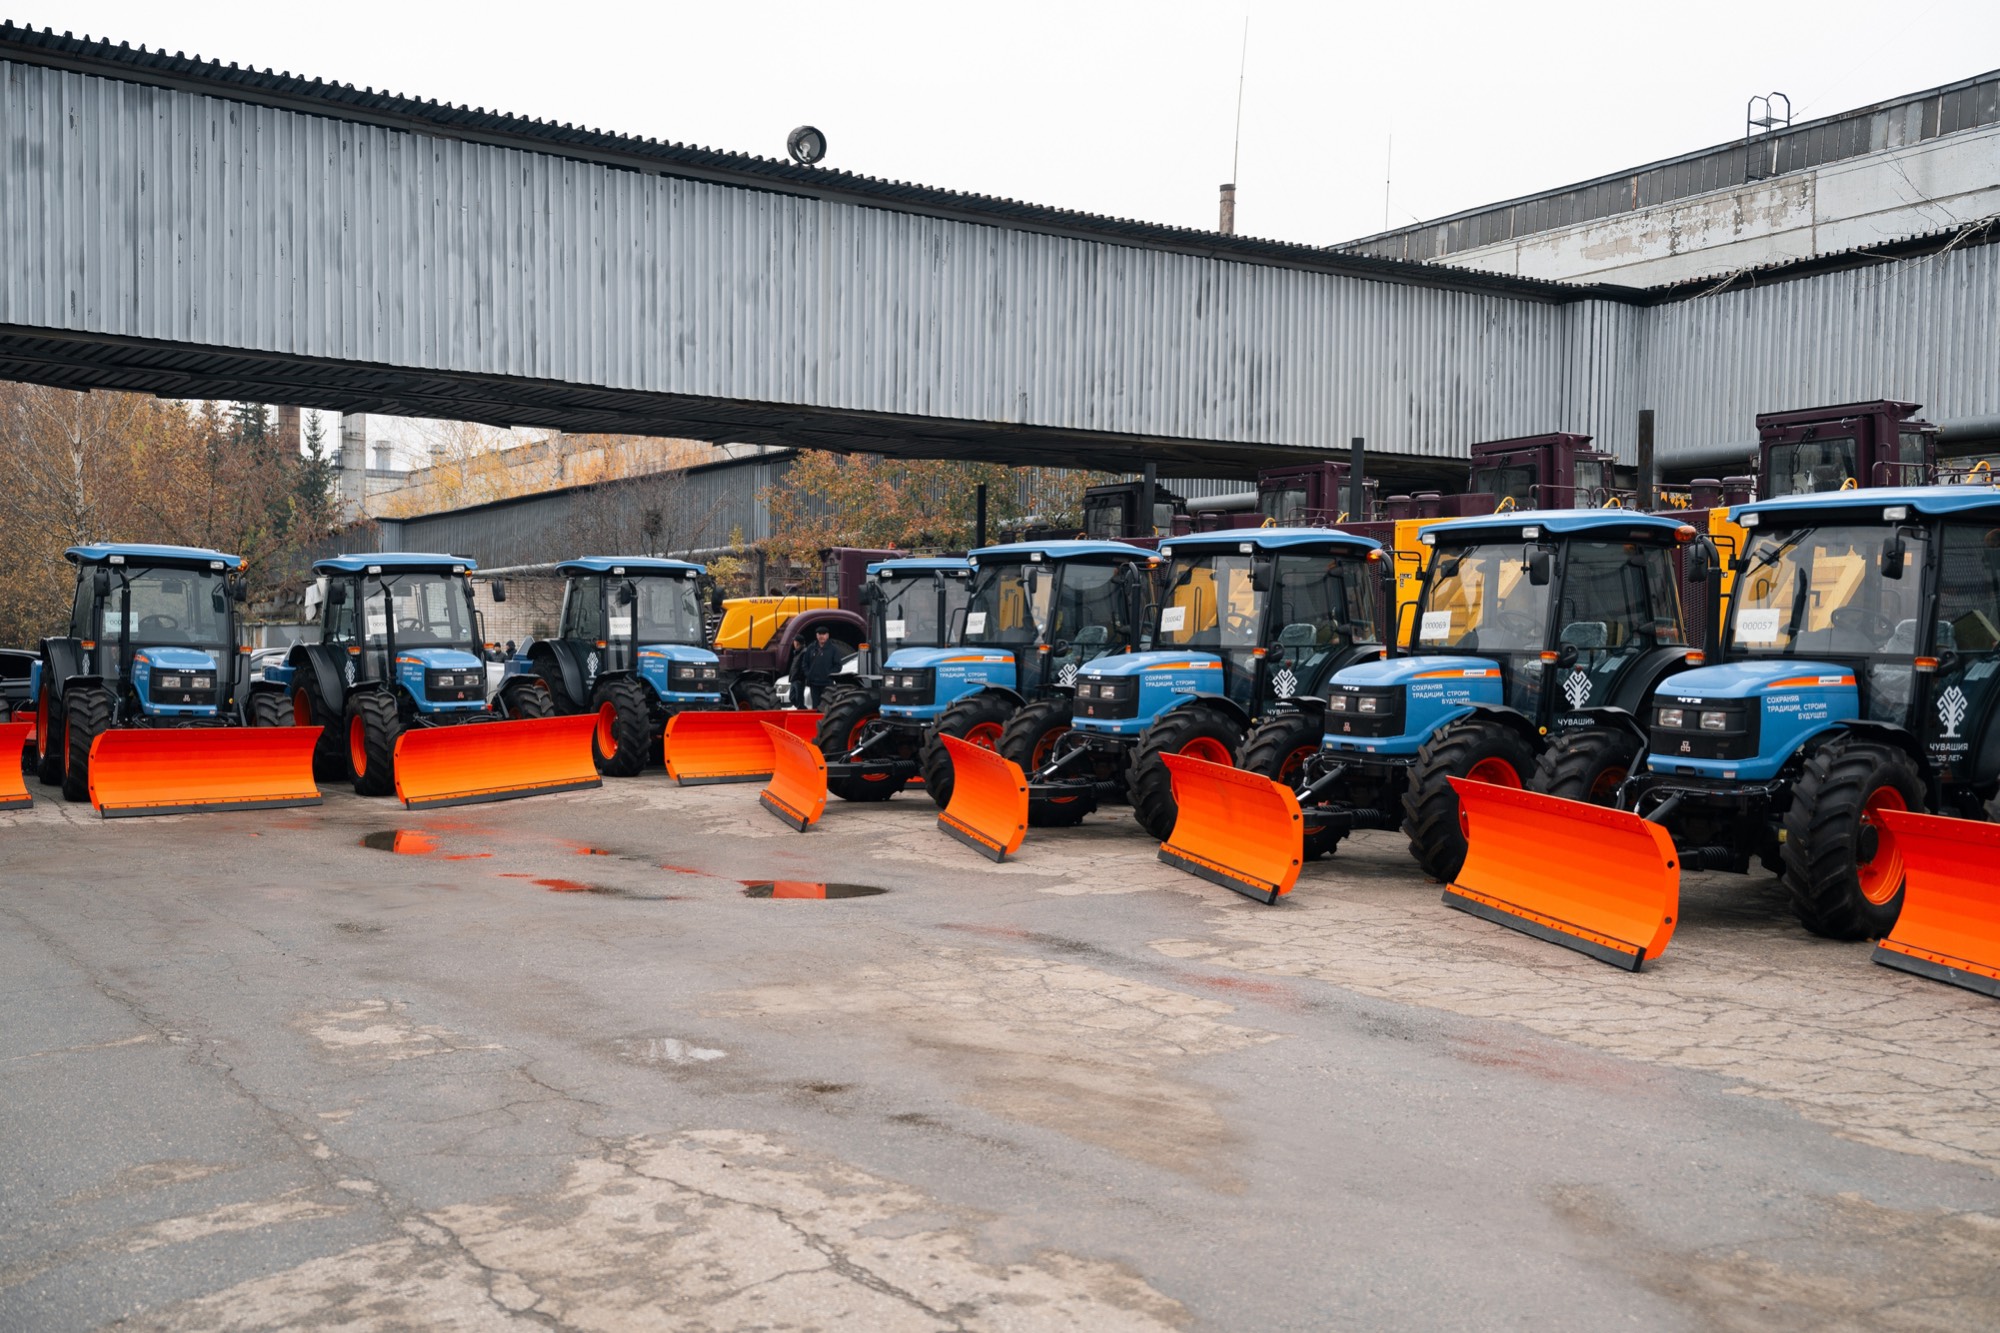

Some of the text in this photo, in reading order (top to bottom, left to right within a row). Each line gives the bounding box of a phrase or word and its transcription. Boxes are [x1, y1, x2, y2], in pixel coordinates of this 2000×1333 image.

[1425, 621, 1447, 630] 000069
[1742, 621, 1773, 630] 000057
[1411, 683, 1443, 692] СОХРАНЯЯ
[1766, 694, 1800, 704] СОХРАНЯЯ
[1767, 702, 1828, 713] ТРАДИЦИИ, СТРОИМ
[1797, 711, 1828, 720] БУДУЩЕЕ!
[1557, 718, 1595, 726] ЧУВАШИЯ
[1929, 743, 1969, 751] ЧУВАШИЯ
